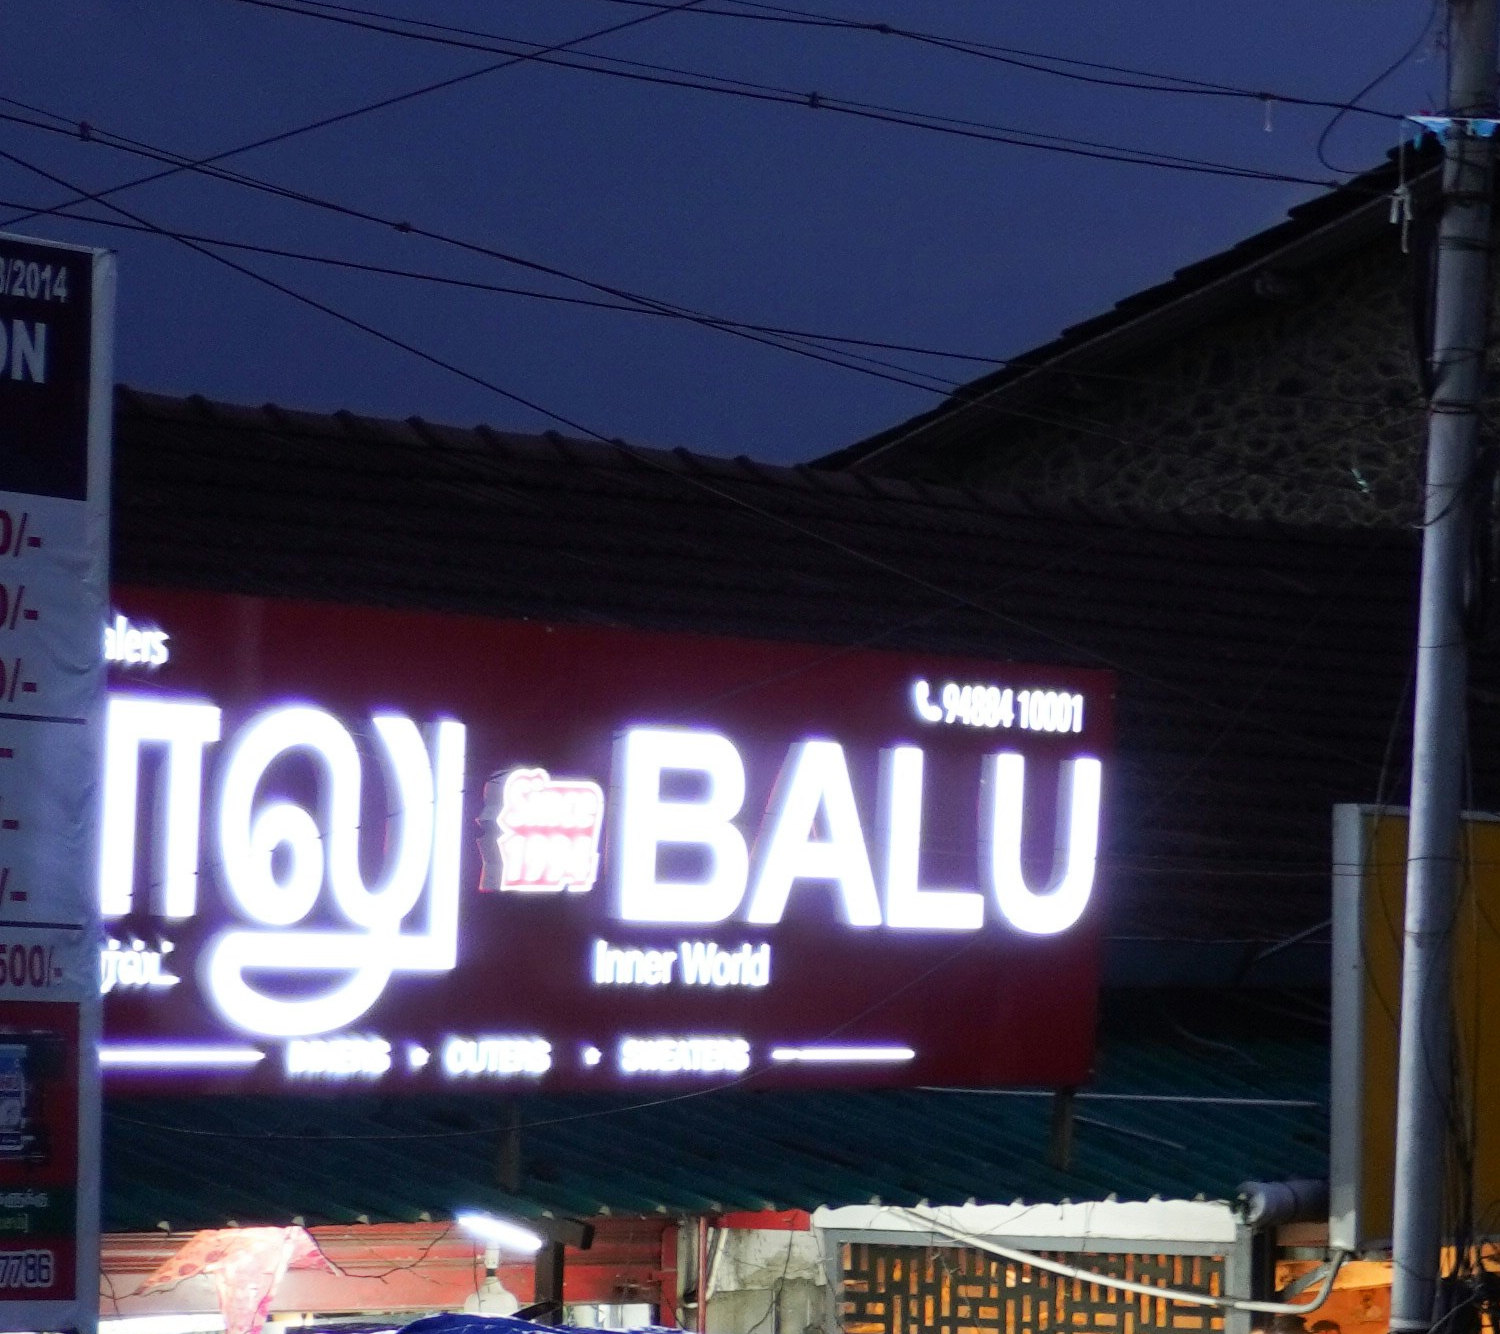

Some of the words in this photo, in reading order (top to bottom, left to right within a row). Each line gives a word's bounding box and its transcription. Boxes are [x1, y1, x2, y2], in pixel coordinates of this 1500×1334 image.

[0, 319, 46, 383] N
[618, 728, 1101, 934] BALU
[594, 940, 677, 985] Inner
[681, 942, 770, 987] World
[445, 1038, 552, 1072] OUTERS
[622, 1038, 751, 1072] SWEATERS
